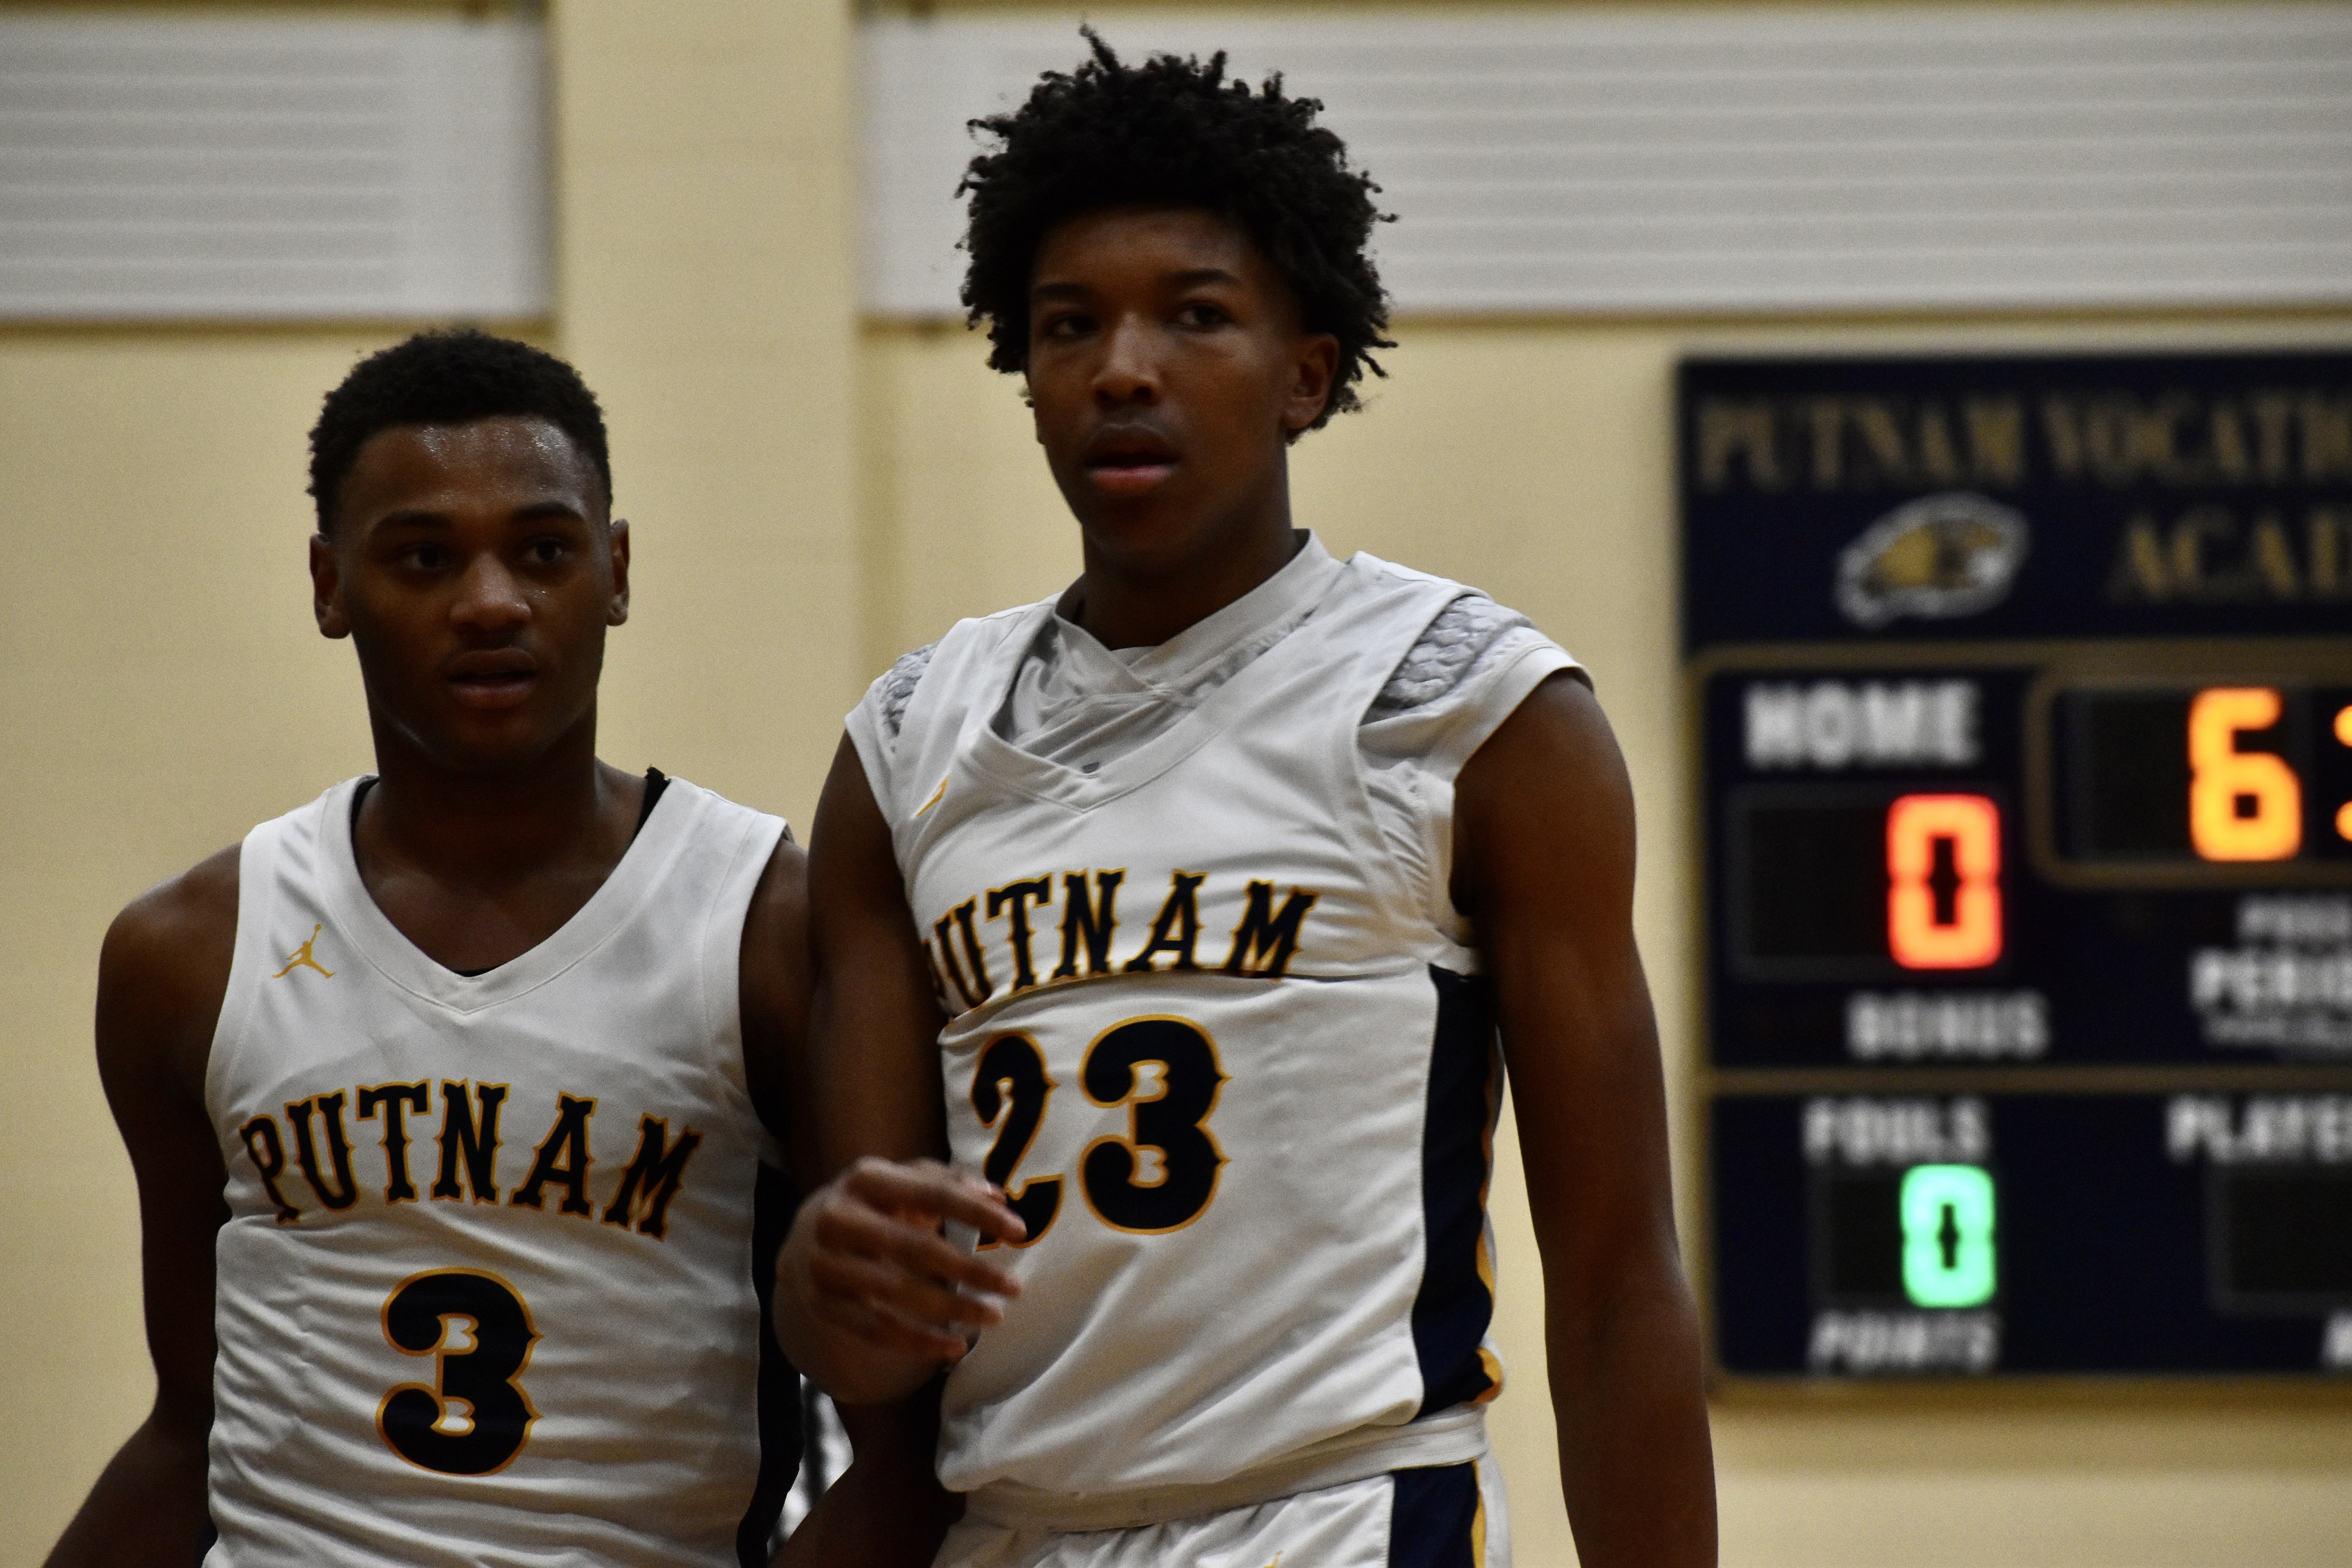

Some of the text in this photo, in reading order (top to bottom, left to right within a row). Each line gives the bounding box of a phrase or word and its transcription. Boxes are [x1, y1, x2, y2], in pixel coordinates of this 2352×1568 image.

[1744, 679, 1980, 767] HOME
[923, 867, 1319, 1019] UTNAM
[1887, 794, 2002, 968] 0
[1846, 993, 2050, 1058] BONUS
[239, 1078, 704, 1241] PUTNAM
[970, 1014, 1233, 1251] 23
[1803, 1098, 1989, 1163] FOULS
[1901, 1164, 1996, 1308] 0
[375, 1267, 544, 1477] 3
